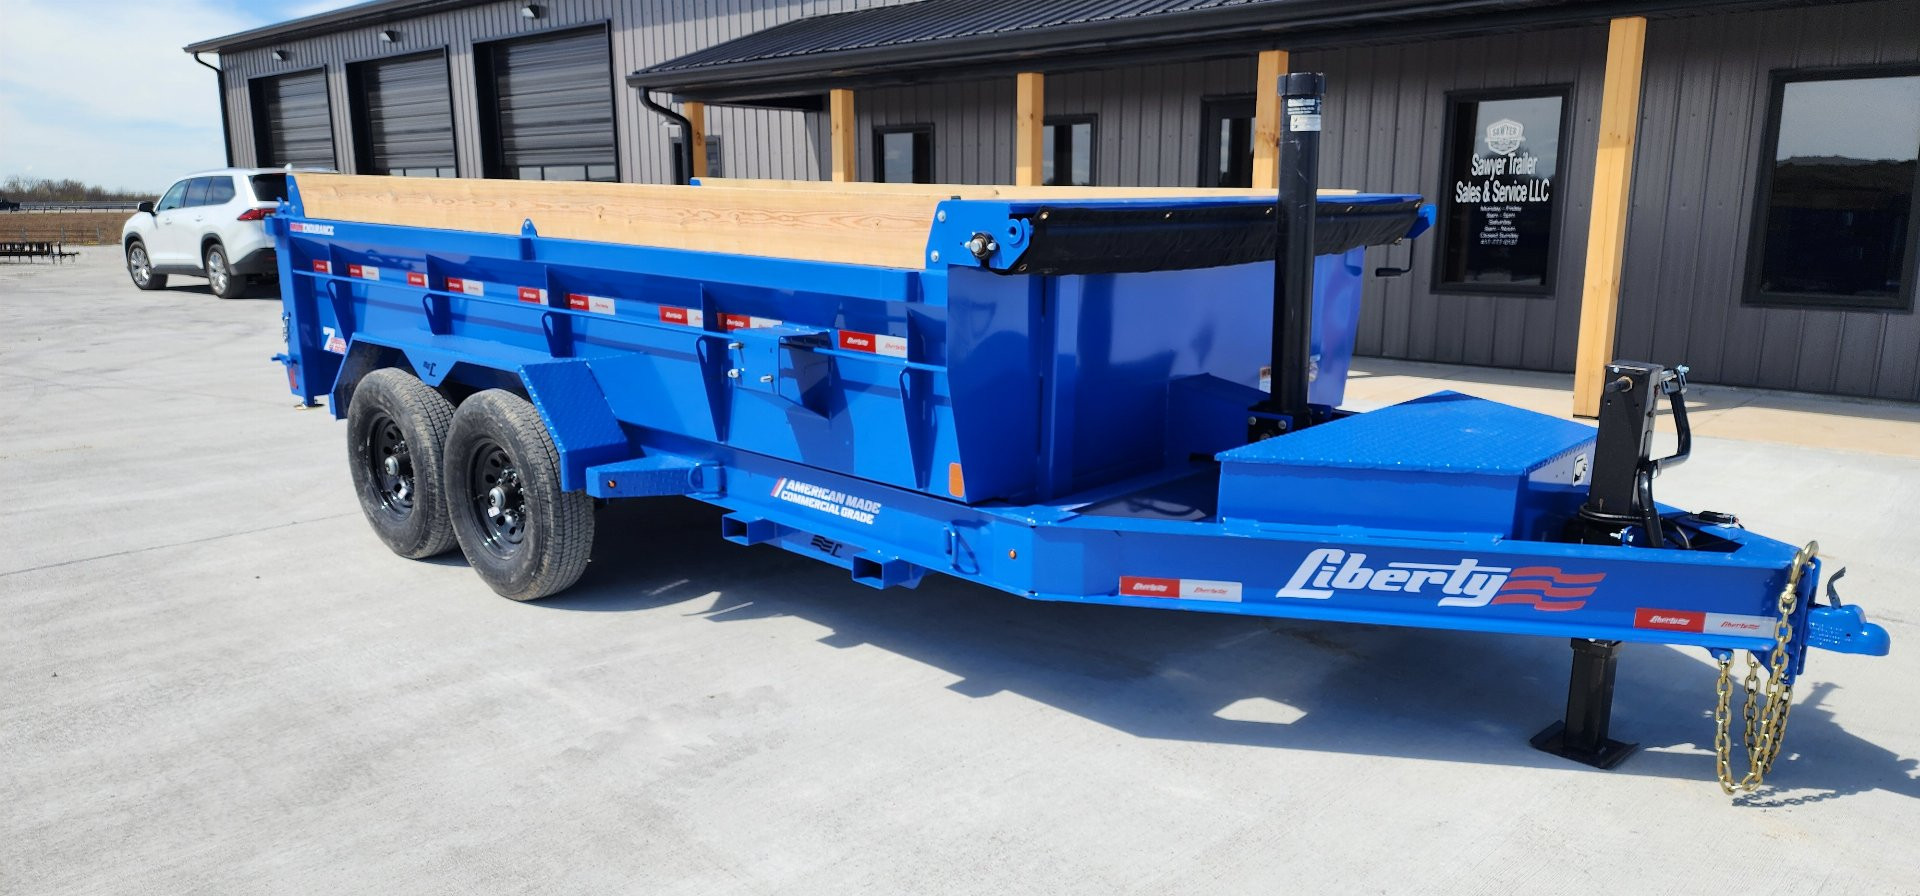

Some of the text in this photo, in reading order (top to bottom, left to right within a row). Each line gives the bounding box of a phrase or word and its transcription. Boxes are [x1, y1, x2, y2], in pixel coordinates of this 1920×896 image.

[1471, 151, 1538, 181] Sawyer Trailer
[1455, 178, 1550, 203] Sales & Service LLC
[781, 490, 875, 525] COMMERCIAL GRADE
[786, 479, 881, 515] AMERICAN MADE
[1276, 548, 1512, 608] Liberty
